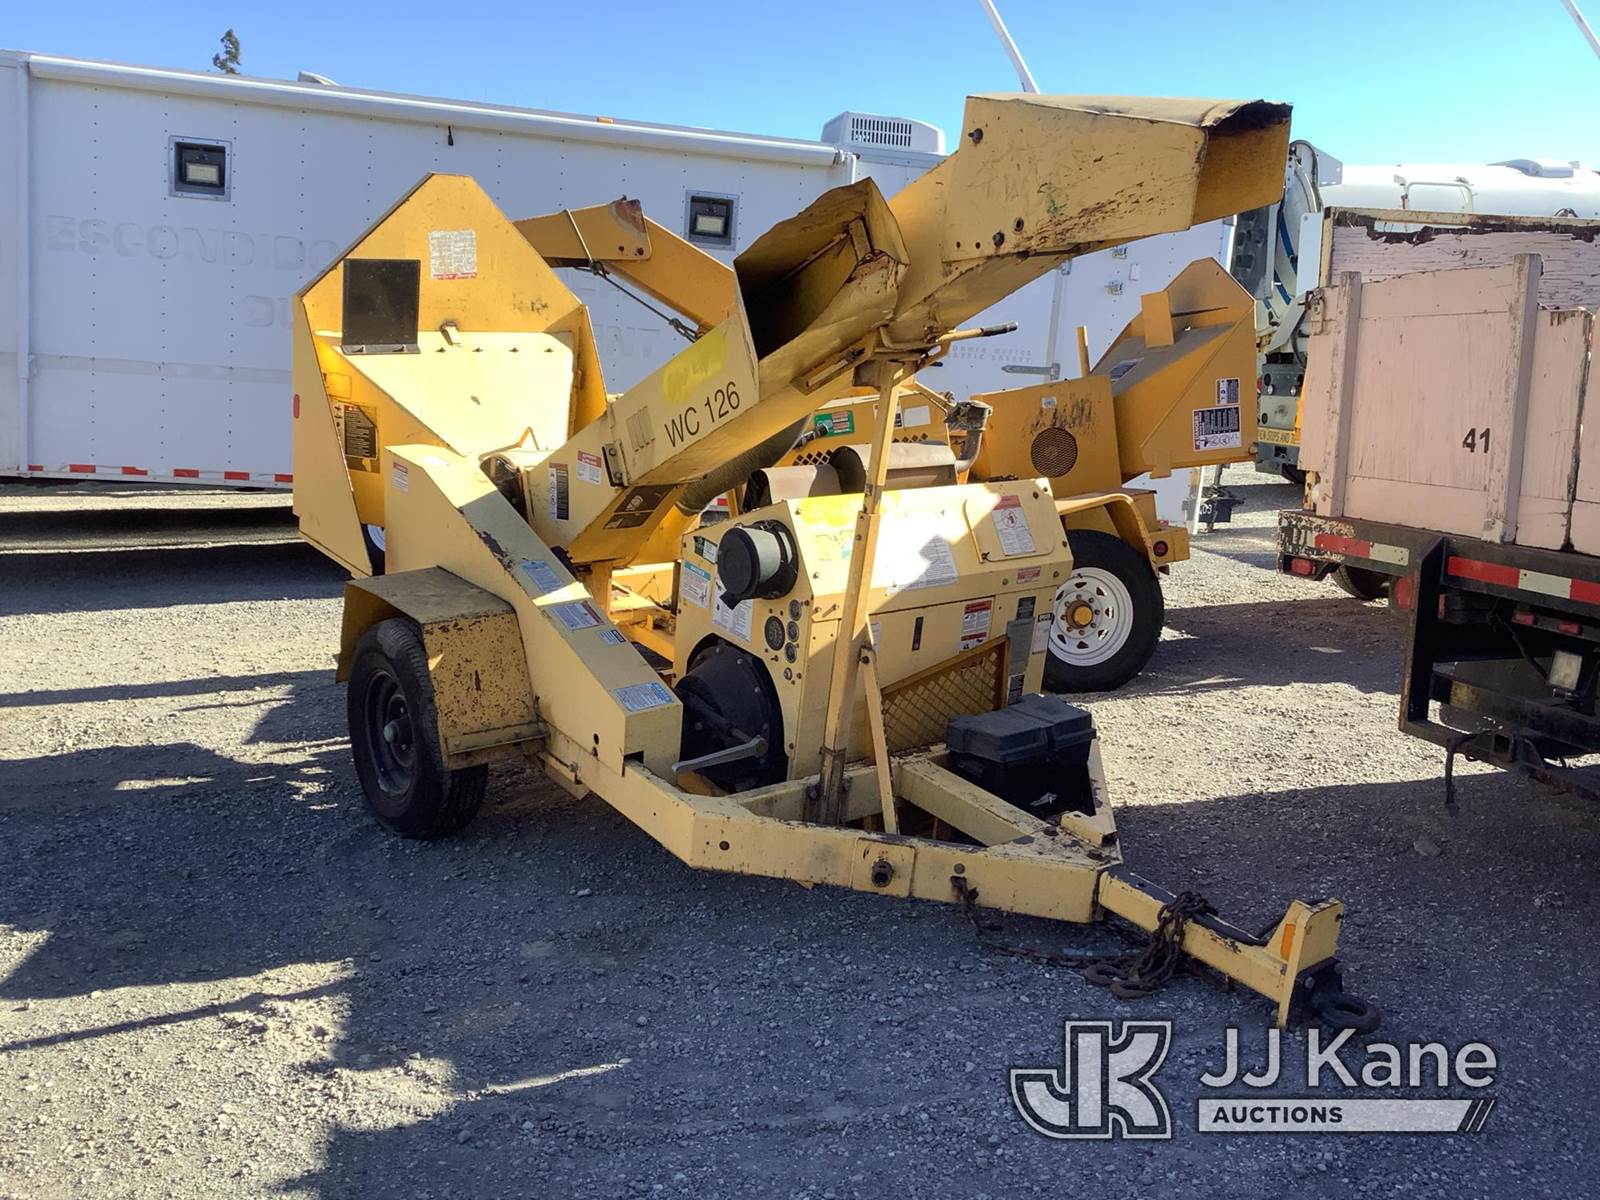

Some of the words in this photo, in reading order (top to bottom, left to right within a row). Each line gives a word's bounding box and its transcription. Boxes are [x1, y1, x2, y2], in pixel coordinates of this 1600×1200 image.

[664, 407, 700, 447] WC
[704, 381, 740, 423] 126
[1462, 427, 1491, 454] 41
